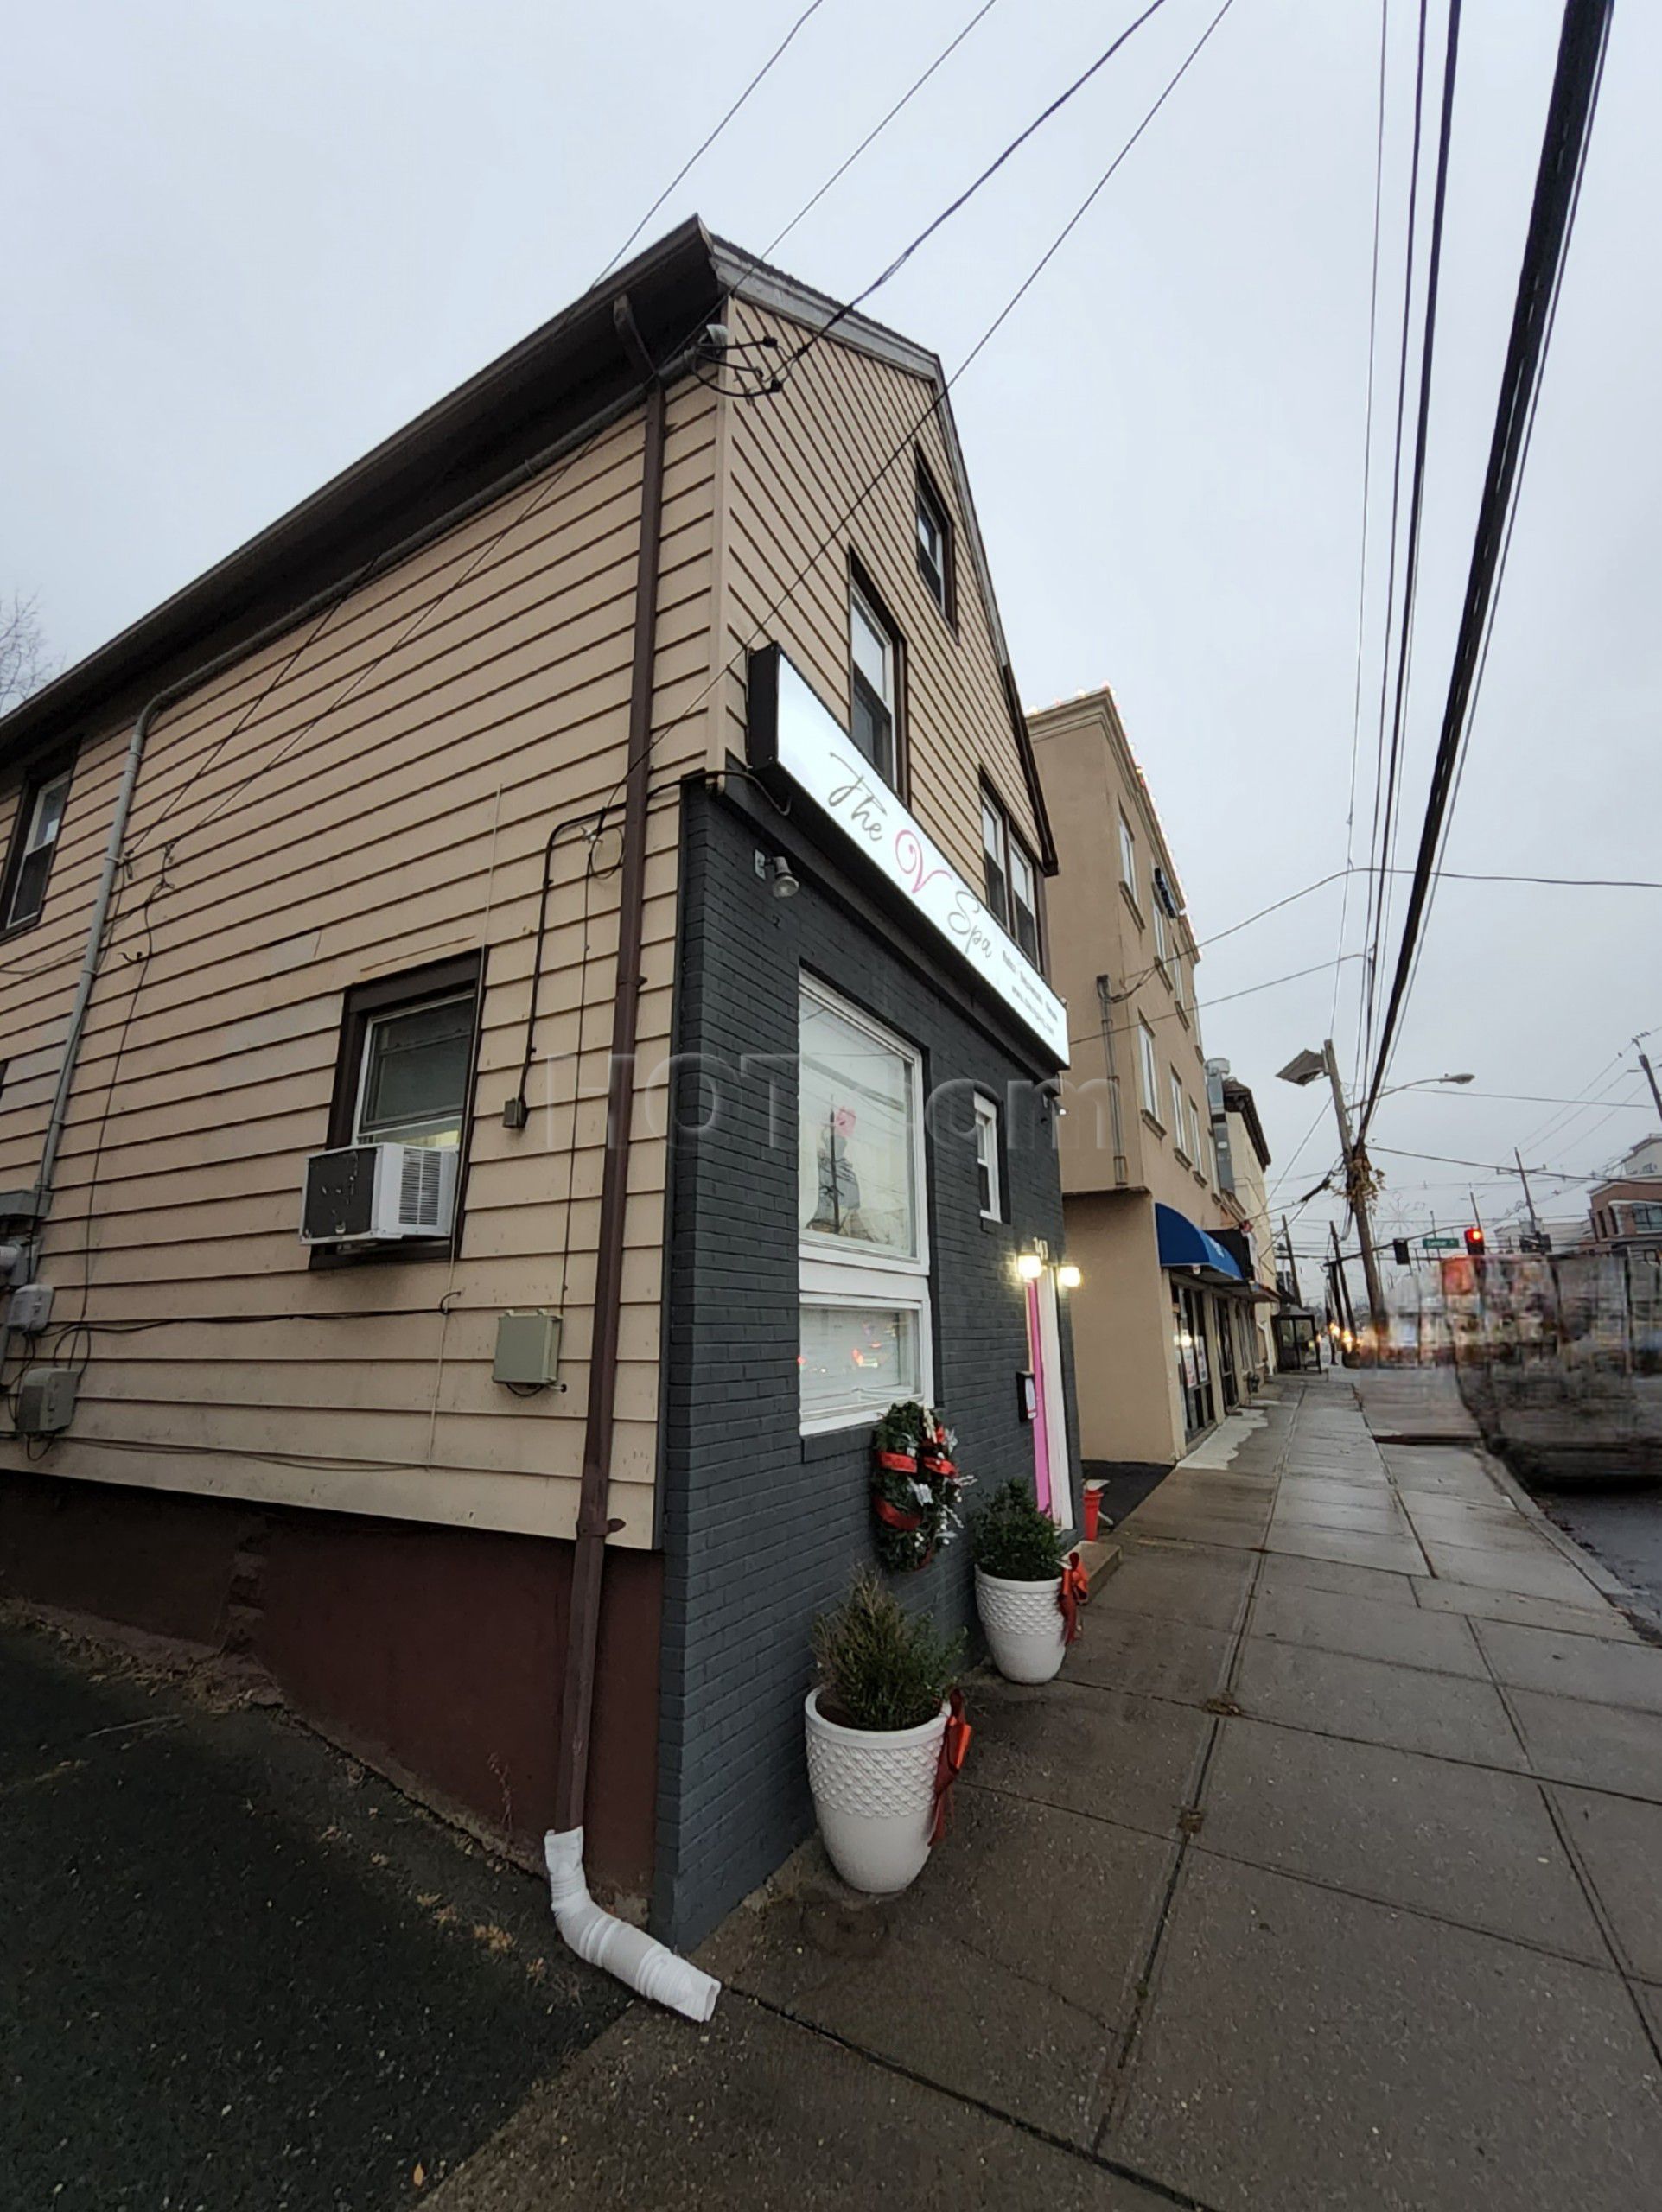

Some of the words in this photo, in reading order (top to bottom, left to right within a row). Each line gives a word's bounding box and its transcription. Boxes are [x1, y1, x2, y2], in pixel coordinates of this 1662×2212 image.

[828, 751, 888, 842] The
[895, 829, 953, 894] V
[947, 890, 993, 958] Spa
